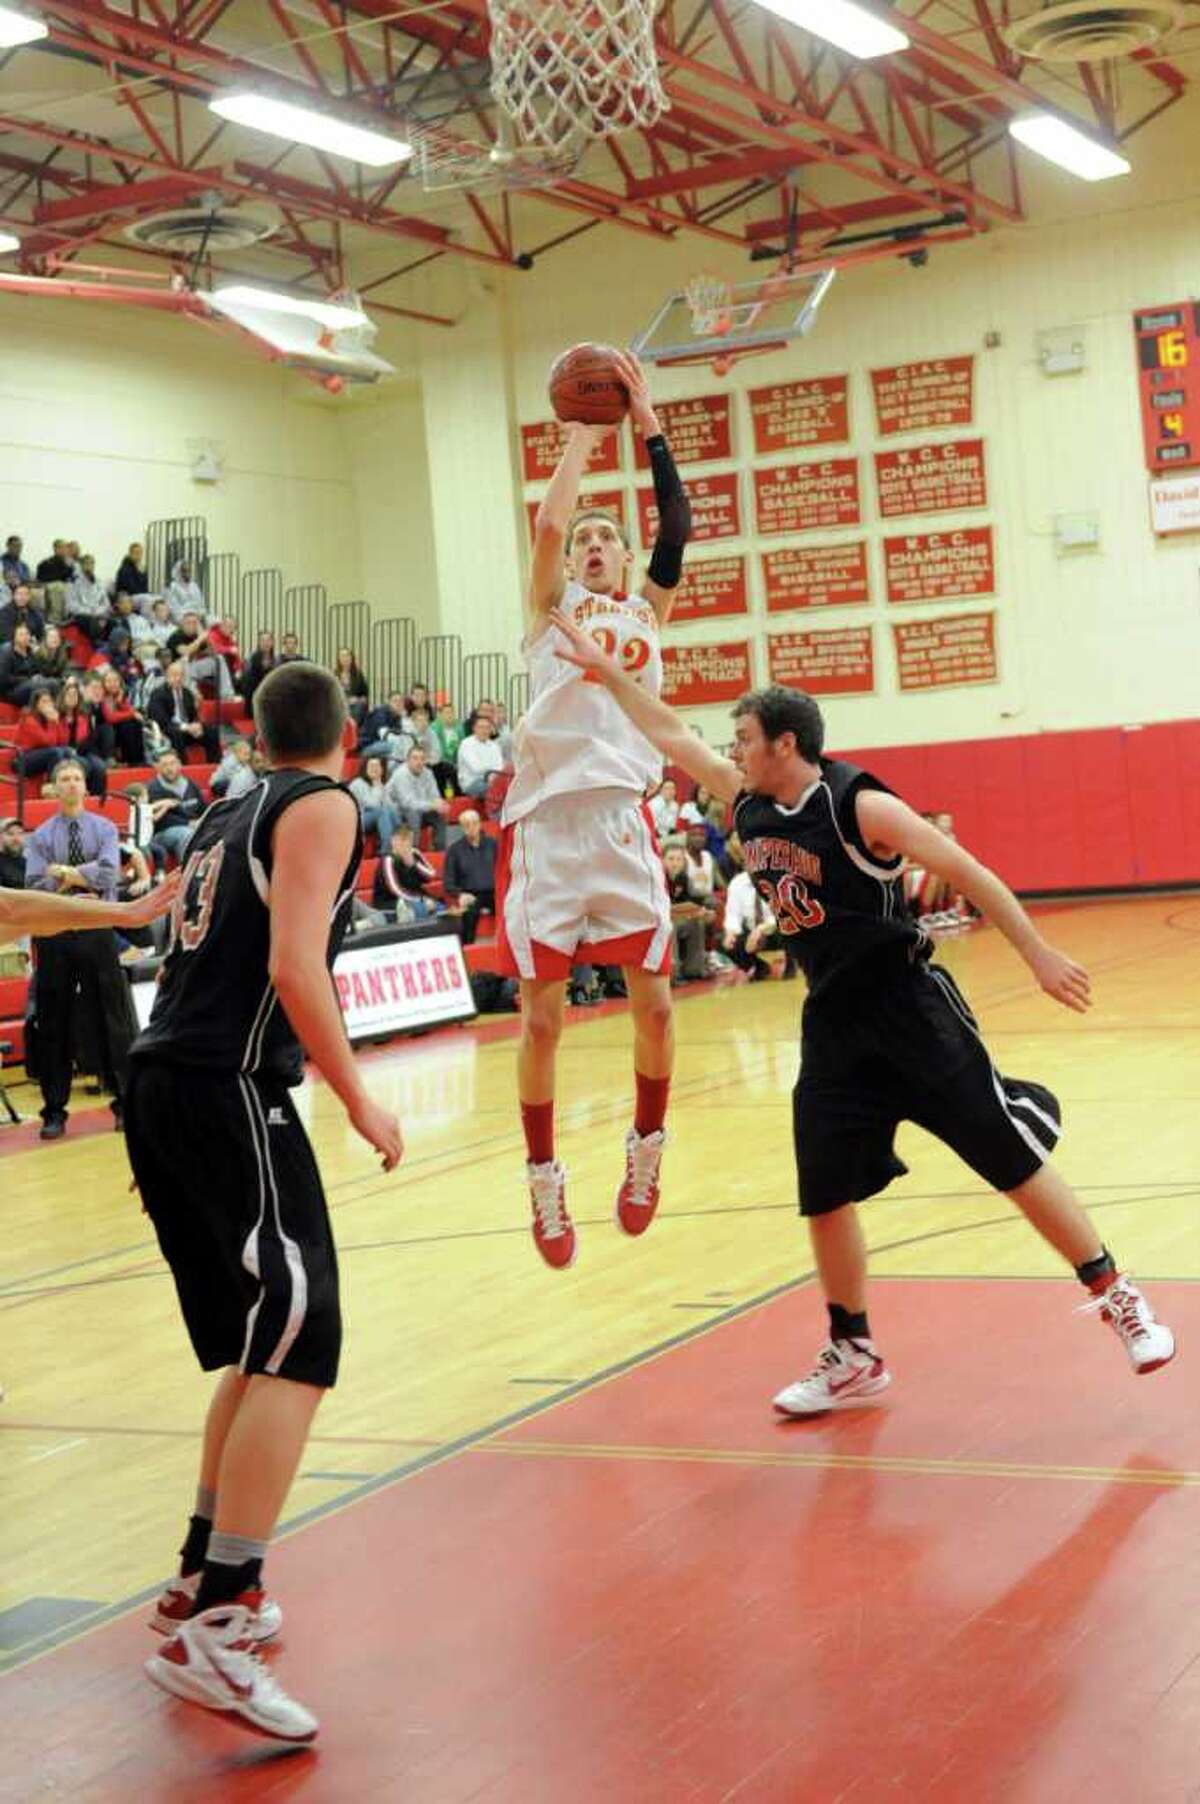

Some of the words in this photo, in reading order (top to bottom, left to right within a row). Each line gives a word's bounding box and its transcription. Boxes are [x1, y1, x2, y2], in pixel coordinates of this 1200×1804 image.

[1157, 331, 1189, 368] 16
[1163, 413, 1184, 438] 4
[335, 953, 463, 1012] PANTHERS
